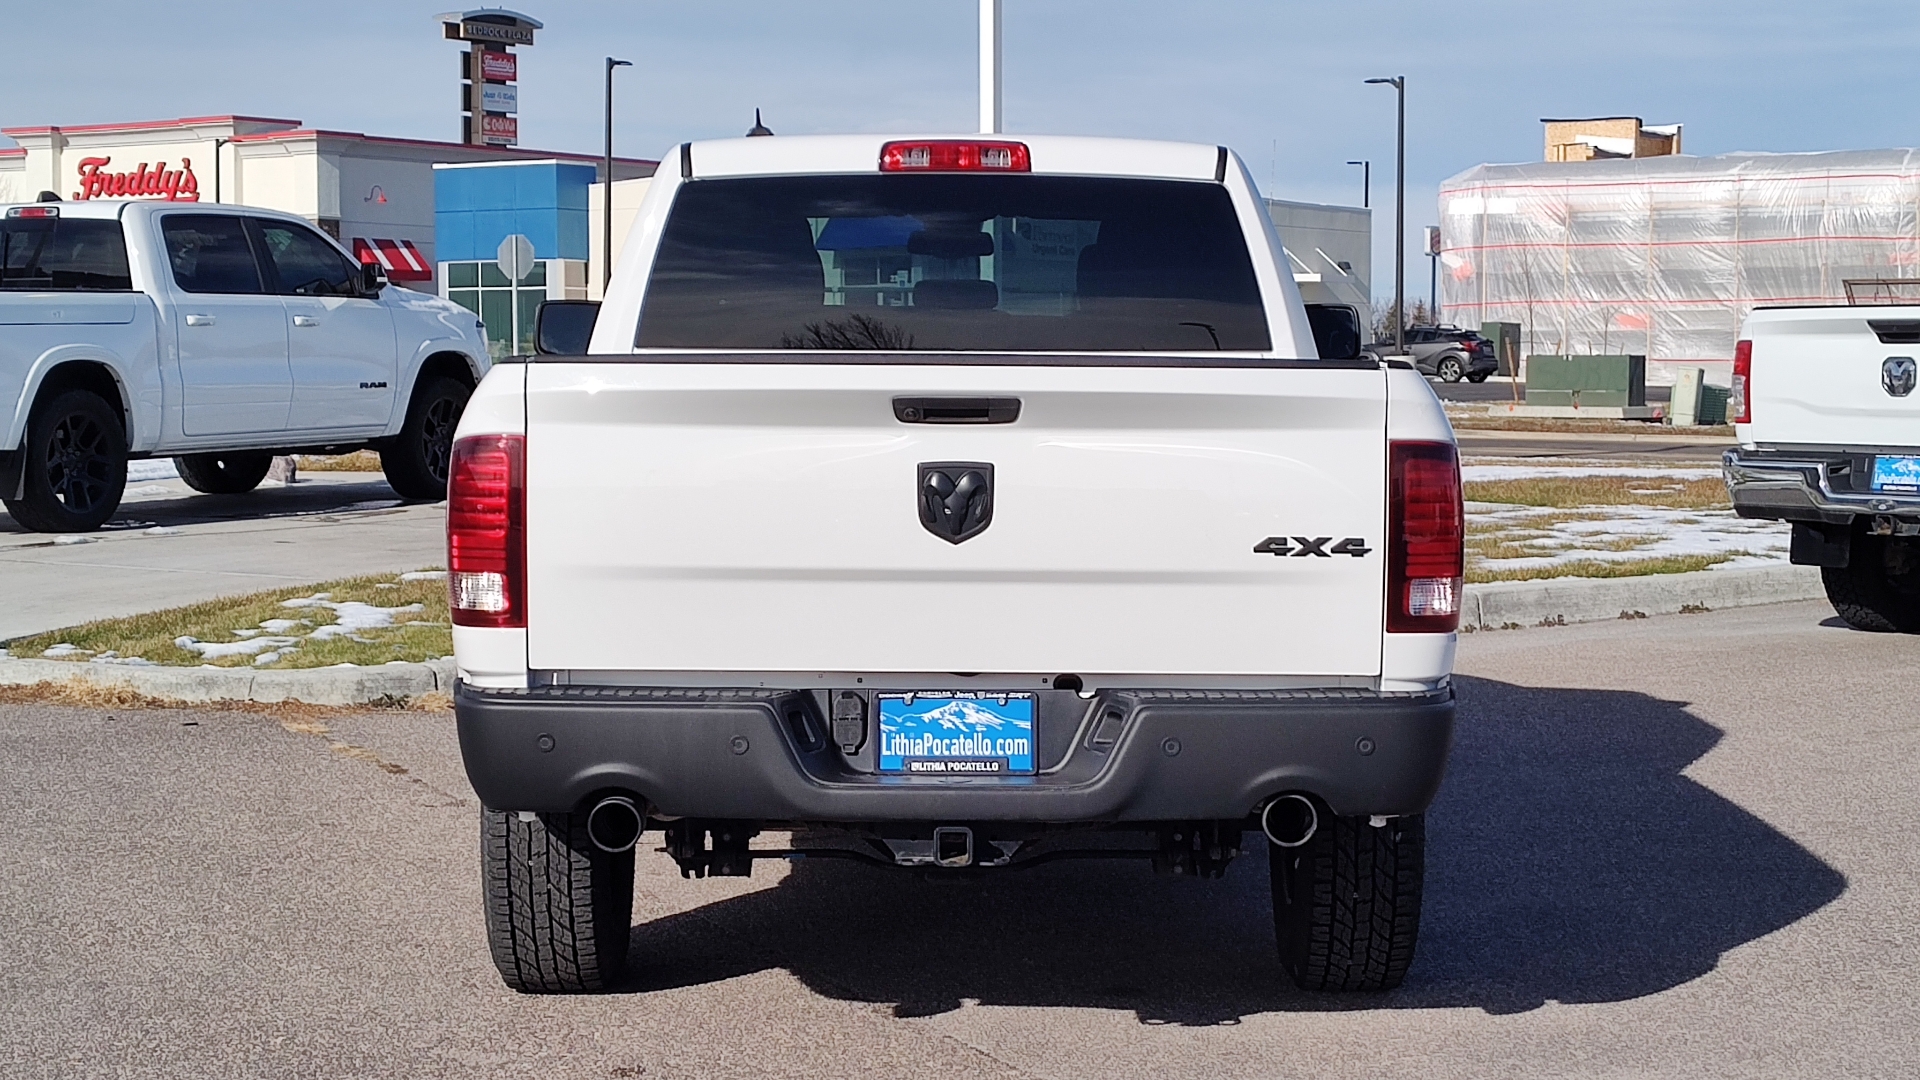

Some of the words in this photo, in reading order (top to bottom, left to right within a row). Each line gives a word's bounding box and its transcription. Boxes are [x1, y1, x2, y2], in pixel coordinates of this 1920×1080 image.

[466, 25, 505, 37] BEDROCK
[507, 29, 532, 40] PLAZA
[483, 54, 515, 72] Freddy's
[73, 156, 200, 202] Freddy's
[882, 733, 1029, 756] LithiaPocatello.com
[948, 762, 999, 772] POCATELLO
